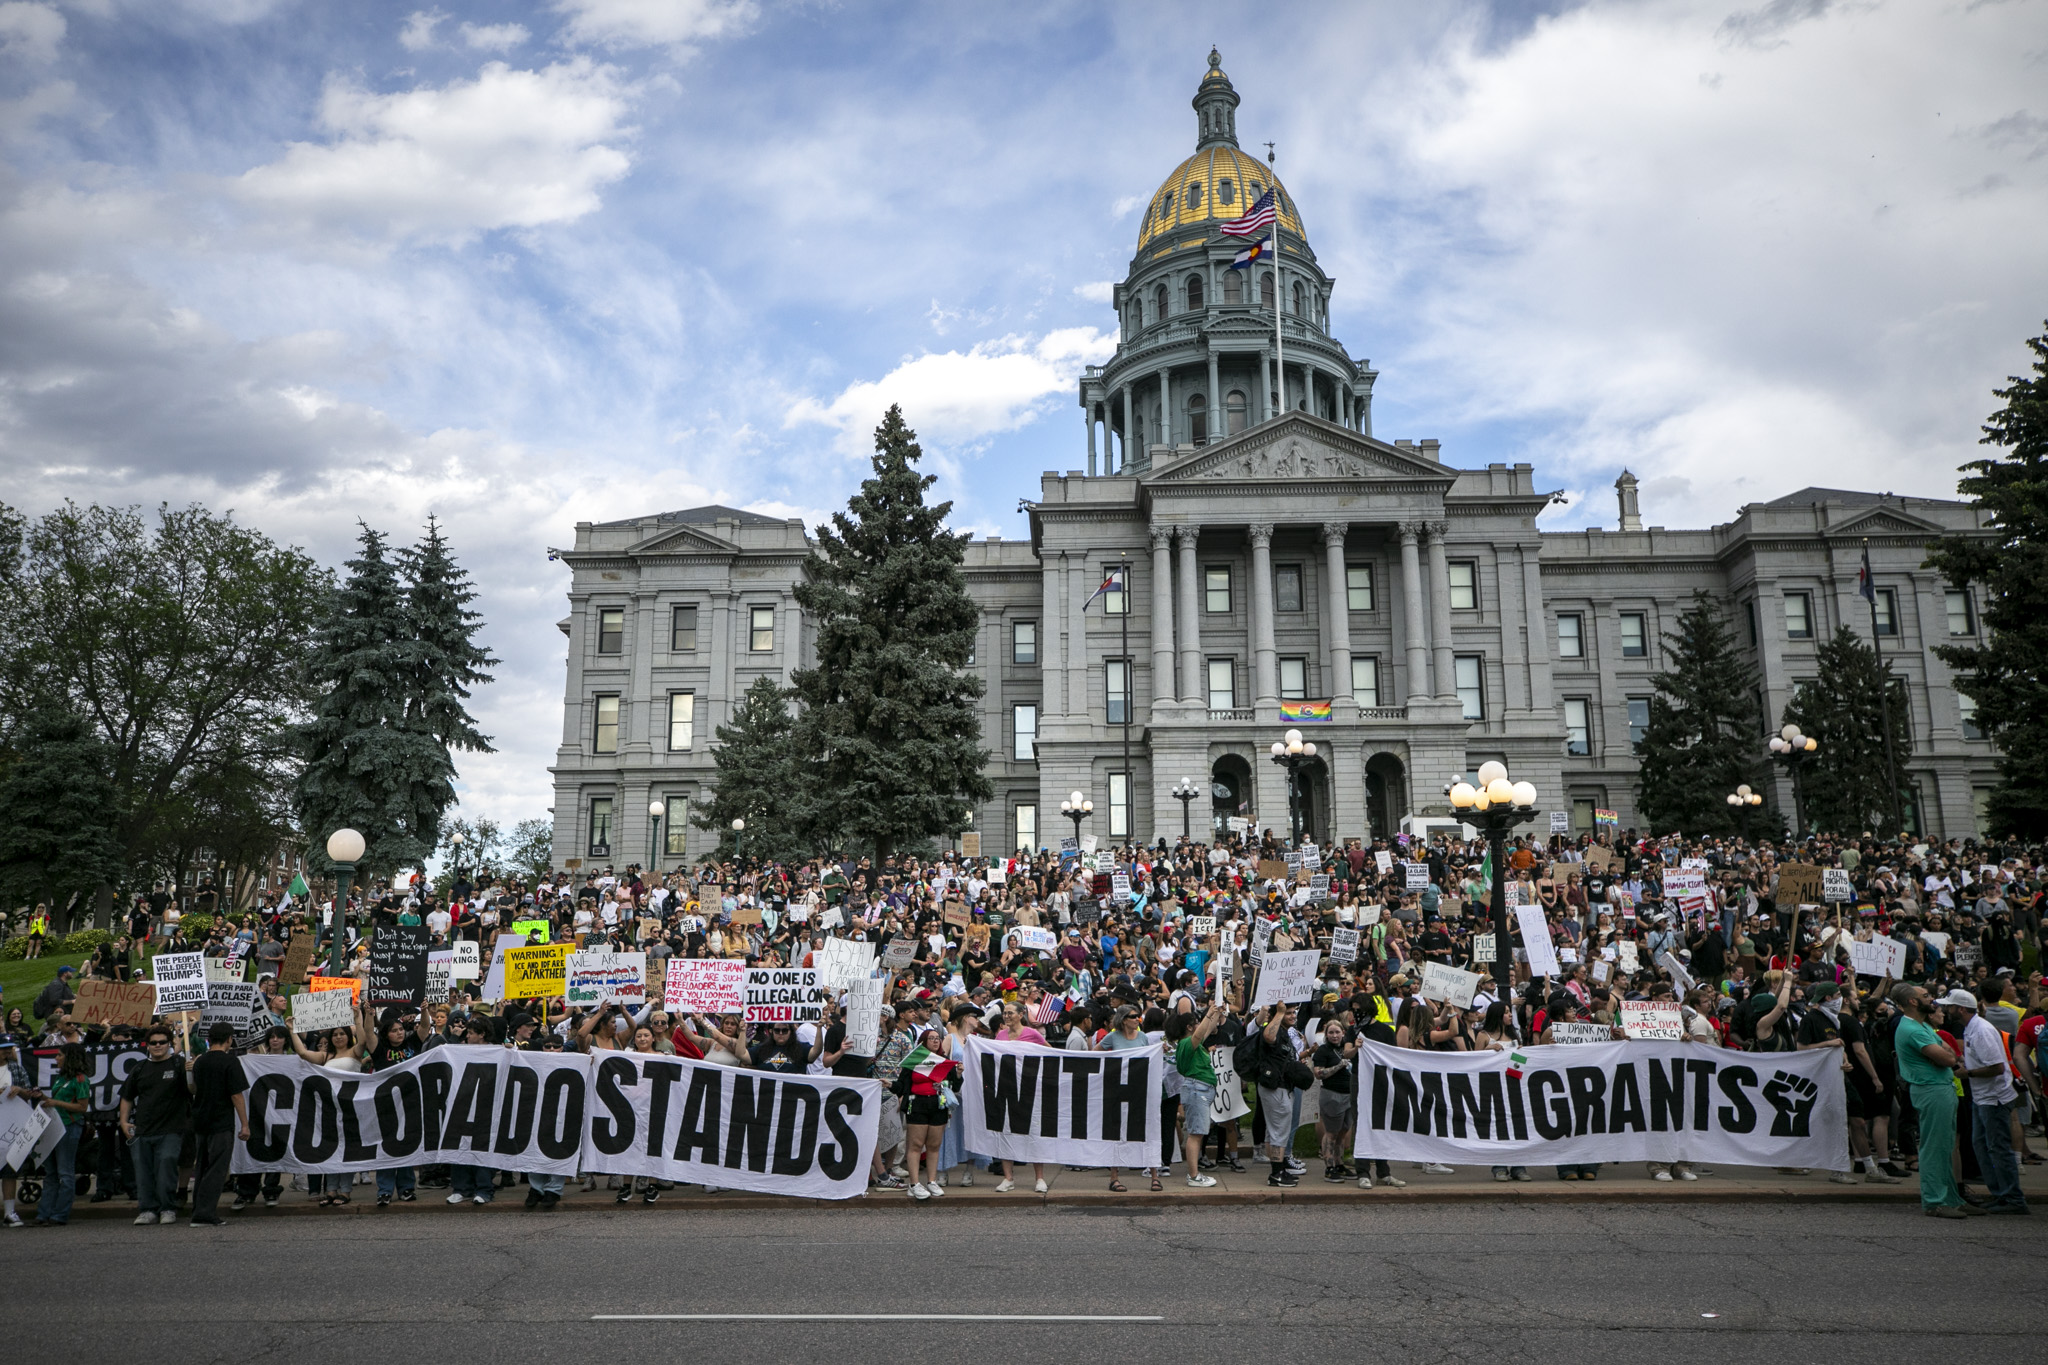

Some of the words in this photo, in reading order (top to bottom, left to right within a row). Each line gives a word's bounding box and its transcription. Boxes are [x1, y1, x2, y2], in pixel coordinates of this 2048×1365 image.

[1504, 882, 1518, 892] UCK
[1665, 882, 1686, 890] HUMAN
[1800, 882, 1820, 902] ALL
[1196, 917, 1212, 925] FUCK
[378, 927, 398, 940] Don't
[401, 931, 416, 944] Say
[391, 942, 398, 950] it
[400, 942, 413, 950] the
[1476, 938, 1494, 949] FUC
[460, 946, 472, 954] NO
[511, 949, 556, 960] WARNING
[1856, 944, 1884, 960] FUCK
[155, 958, 170, 966] THE
[172, 955, 201, 964] PEOPLE
[453, 956, 478, 964] KINGS
[570, 955, 592, 968] WE
[602, 954, 621, 966] ARE
[1264, 958, 1278, 970] NO
[1281, 956, 1297, 968] ONE
[1303, 954, 1313, 966] IS
[156, 964, 174, 972] WILL
[176, 962, 202, 970] DEFEAT
[372, 964, 394, 973] there
[399, 964, 407, 972] is
[514, 962, 525, 970] ICE
[670, 960, 686, 970] IF
[690, 961, 746, 973] IMMIGRANT
[157, 969, 202, 981] TRUMP'S
[426, 972, 449, 980] STAND
[522, 967, 566, 980] APARTHEID
[668, 972, 700, 982] PEOPLE
[722, 974, 742, 982] SUCH
[748, 972, 769, 984] NO
[773, 972, 800, 985] ONE
[802, 972, 816, 986] IS
[370, 976, 390, 986] NO
[1283, 978, 1294, 986] ON
[79, 982, 153, 1004] CHINGA
[160, 983, 204, 994] BILLIONAIRE
[370, 988, 414, 1000] PATHWAY
[1267, 987, 1292, 1000] STOLEN
[160, 990, 205, 1003] AGENDA!
[208, 992, 218, 1000] LA
[222, 992, 252, 1001] CLASE
[666, 990, 684, 998] ARE
[686, 991, 702, 999] YOU
[705, 992, 739, 1000] LOOKING
[807, 988, 822, 1003] ON
[103, 1002, 122, 1014] TU
[322, 998, 350, 1012] FEAR
[1620, 1001, 1681, 1012] DEPORTATION
[84, 1004, 146, 1027] MAGA!
[746, 1006, 792, 1021] STOLEN
[794, 1006, 822, 1021] LAND
[1641, 1012, 1656, 1022] IS
[858, 1011, 880, 1031] FU
[1628, 1021, 1656, 1030] SMALL
[1659, 1021, 1680, 1029] DICK
[1554, 1024, 1562, 1032] I
[1568, 1024, 1594, 1035] DRINK
[1596, 1027, 1610, 1038] MY
[1641, 1029, 1682, 1038] ENERGY
[38, 1054, 148, 1089] FUC
[1224, 1070, 1232, 1084] OF
[246, 1060, 585, 1164] COLORADO
[592, 1056, 863, 1181] STANDS
[981, 1052, 1150, 1142] WITH
[1371, 1057, 1758, 1141] IMMIGRANTS
